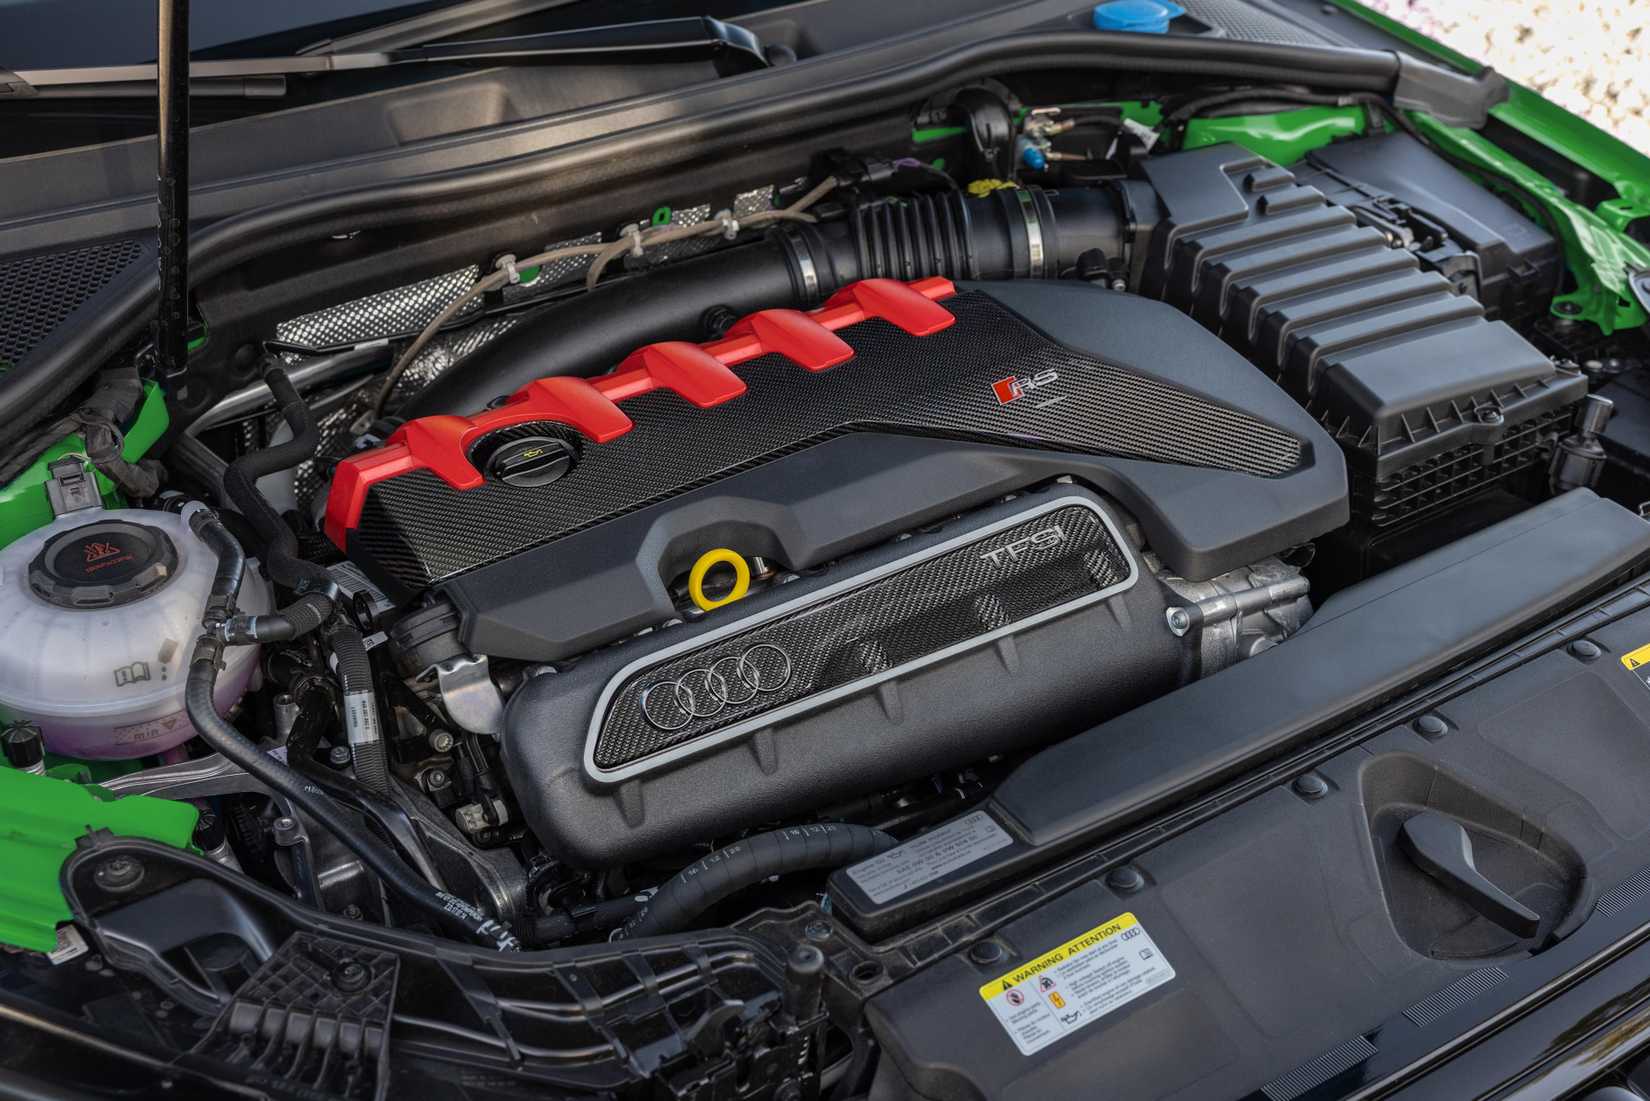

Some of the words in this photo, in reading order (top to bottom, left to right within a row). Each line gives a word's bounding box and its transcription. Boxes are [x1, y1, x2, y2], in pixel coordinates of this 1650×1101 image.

[1011, 368, 1058, 396] RS
[980, 525, 1066, 568] TFSI
[1013, 954, 1064, 984] WARNING
[1067, 923, 1122, 956] ATTENTION
